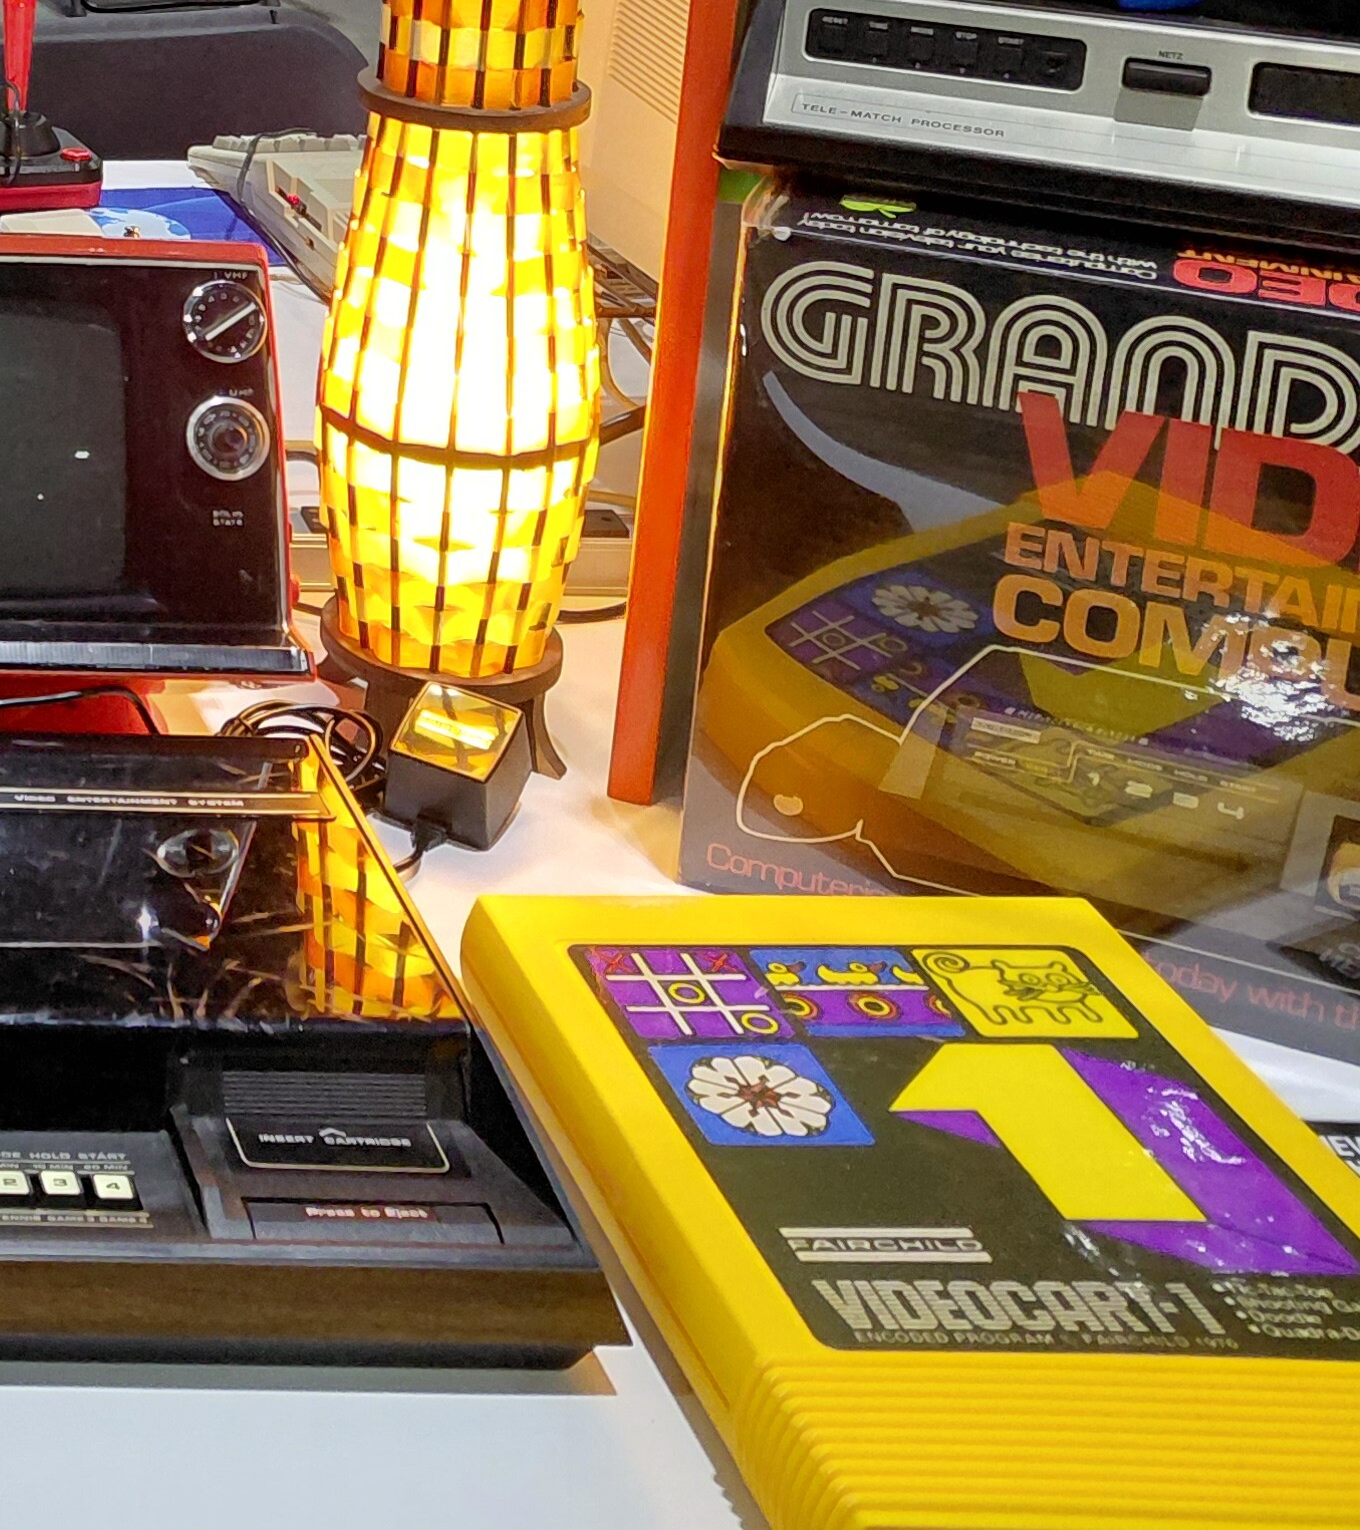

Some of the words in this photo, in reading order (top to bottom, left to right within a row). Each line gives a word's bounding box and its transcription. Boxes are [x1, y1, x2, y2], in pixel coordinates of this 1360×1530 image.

[1158, 50, 1183, 60] NETZ
[911, 117, 1005, 138] PROCESSOR
[797, 215, 857, 237] today
[859, 226, 954, 251] television
[958, 242, 1007, 257] your
[761, 260, 1360, 455] GRAND
[890, 1042, 1207, 1222] 1
[30, 1152, 71, 1160] HOLD
[77, 1152, 126, 1161] START
[788, 1238, 984, 1253] FAIRCHILD
[811, 1280, 1226, 1334] VIDEOCART-1
